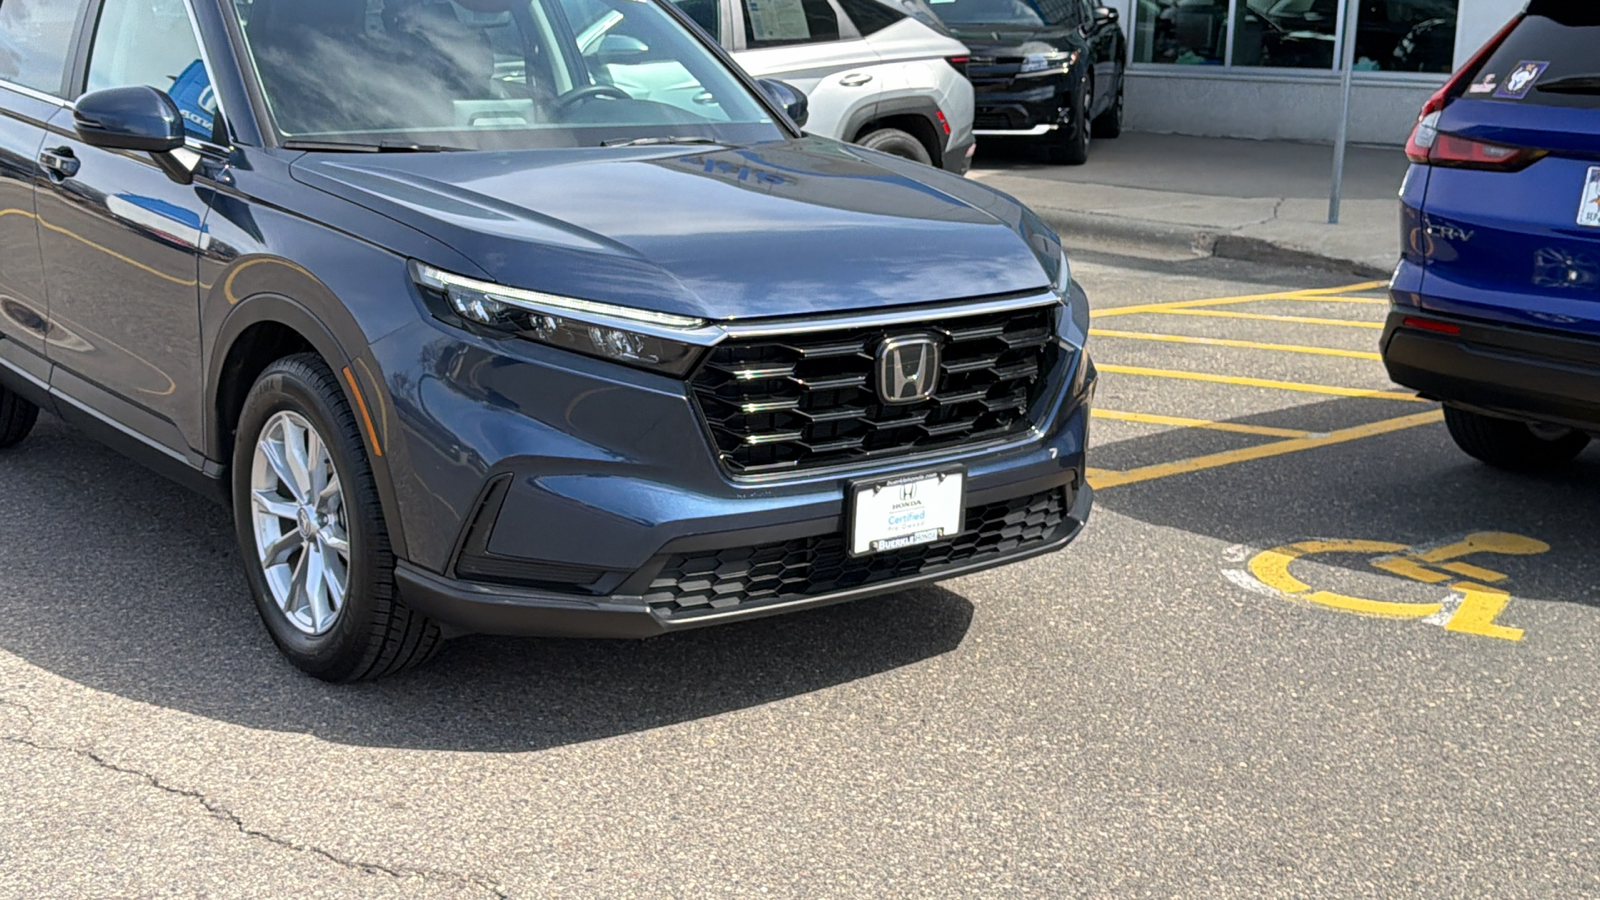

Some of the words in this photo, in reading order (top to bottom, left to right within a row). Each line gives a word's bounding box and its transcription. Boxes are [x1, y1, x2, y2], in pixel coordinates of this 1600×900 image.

[1427, 224, 1475, 241] CR-V
[892, 499, 922, 509] HONDA
[888, 510, 925, 525] Certified
